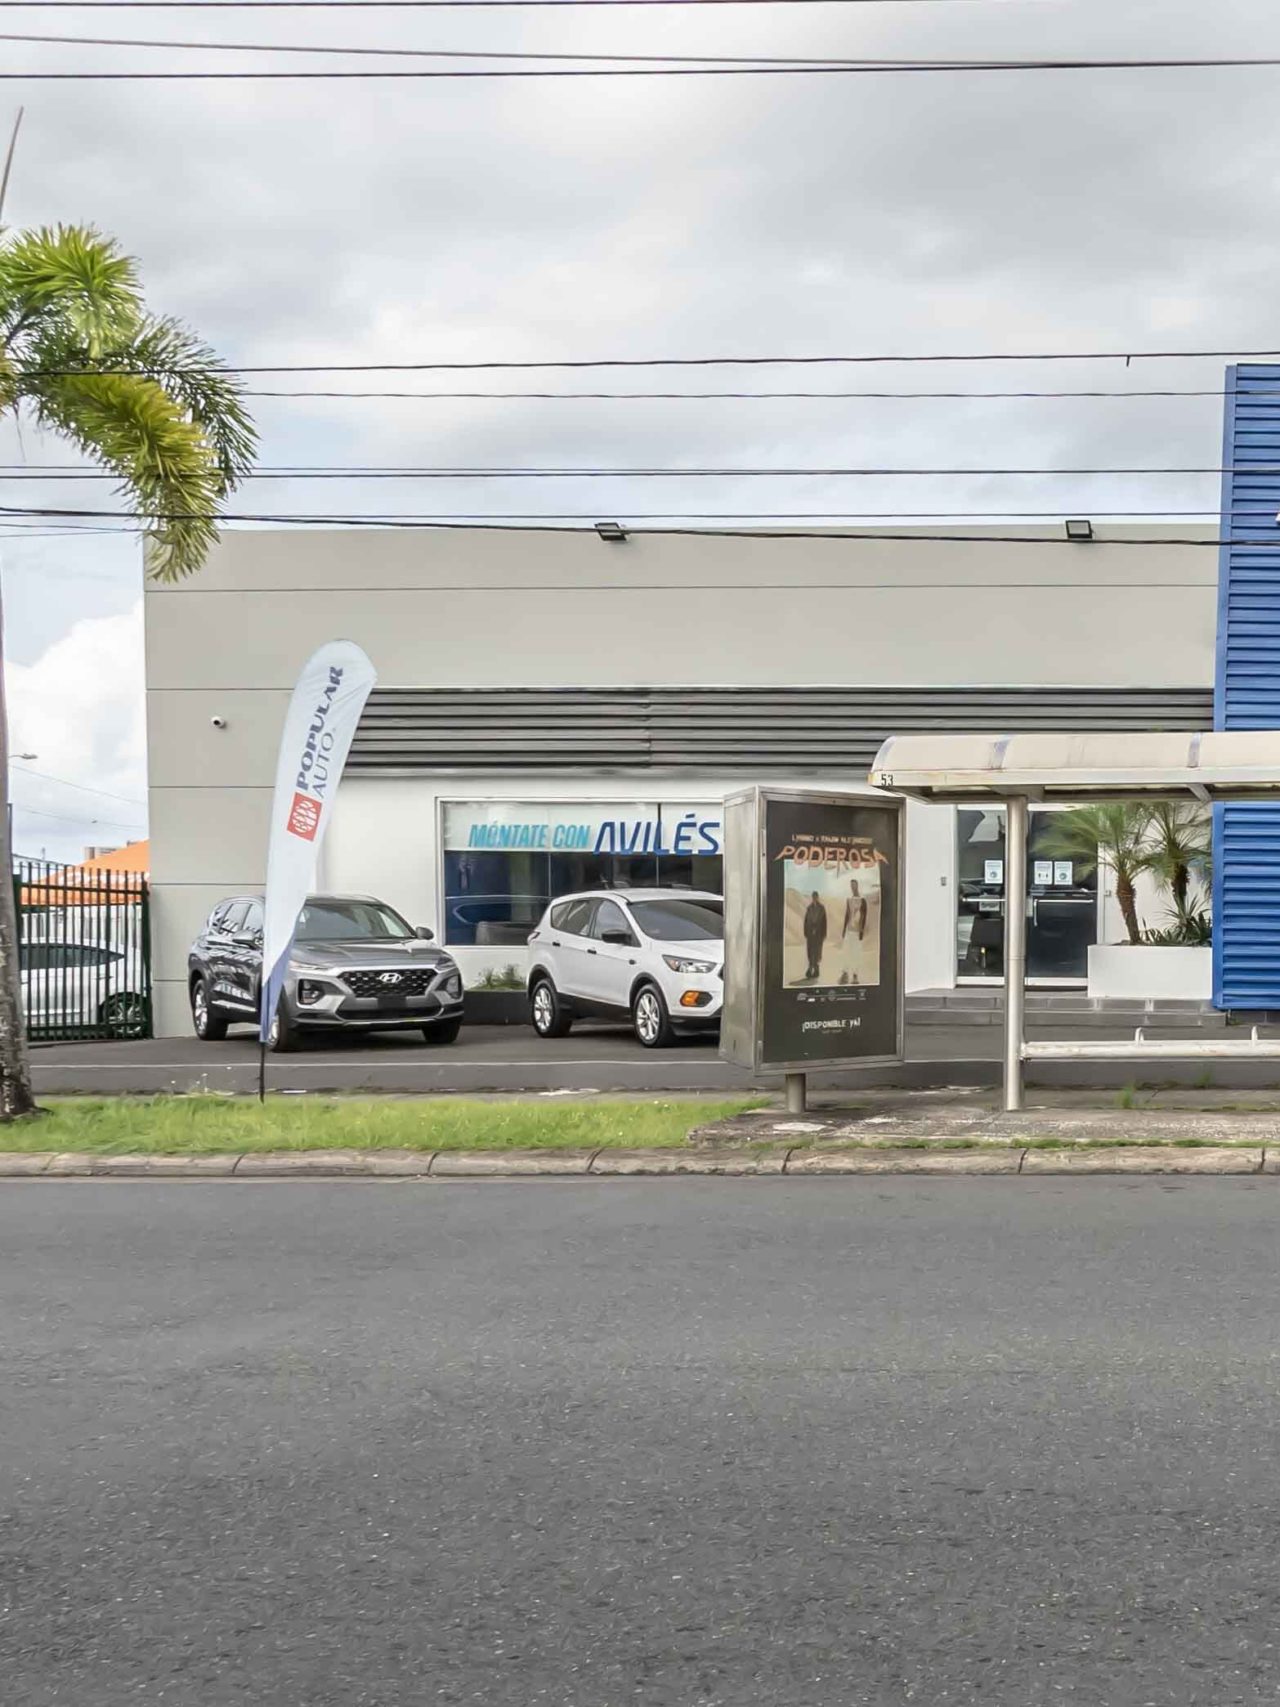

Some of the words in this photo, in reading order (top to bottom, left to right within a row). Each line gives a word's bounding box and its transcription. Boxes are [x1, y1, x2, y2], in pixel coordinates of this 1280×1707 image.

[296, 665, 344, 791] POPULAR
[312, 731, 336, 799] AUTO
[881, 773, 894, 787] 53
[468, 820, 549, 848] MÓNTATE
[552, 824, 591, 849] CON
[592, 813, 721, 856] AVILÉS
[774, 844, 889, 873] PODEROSA
